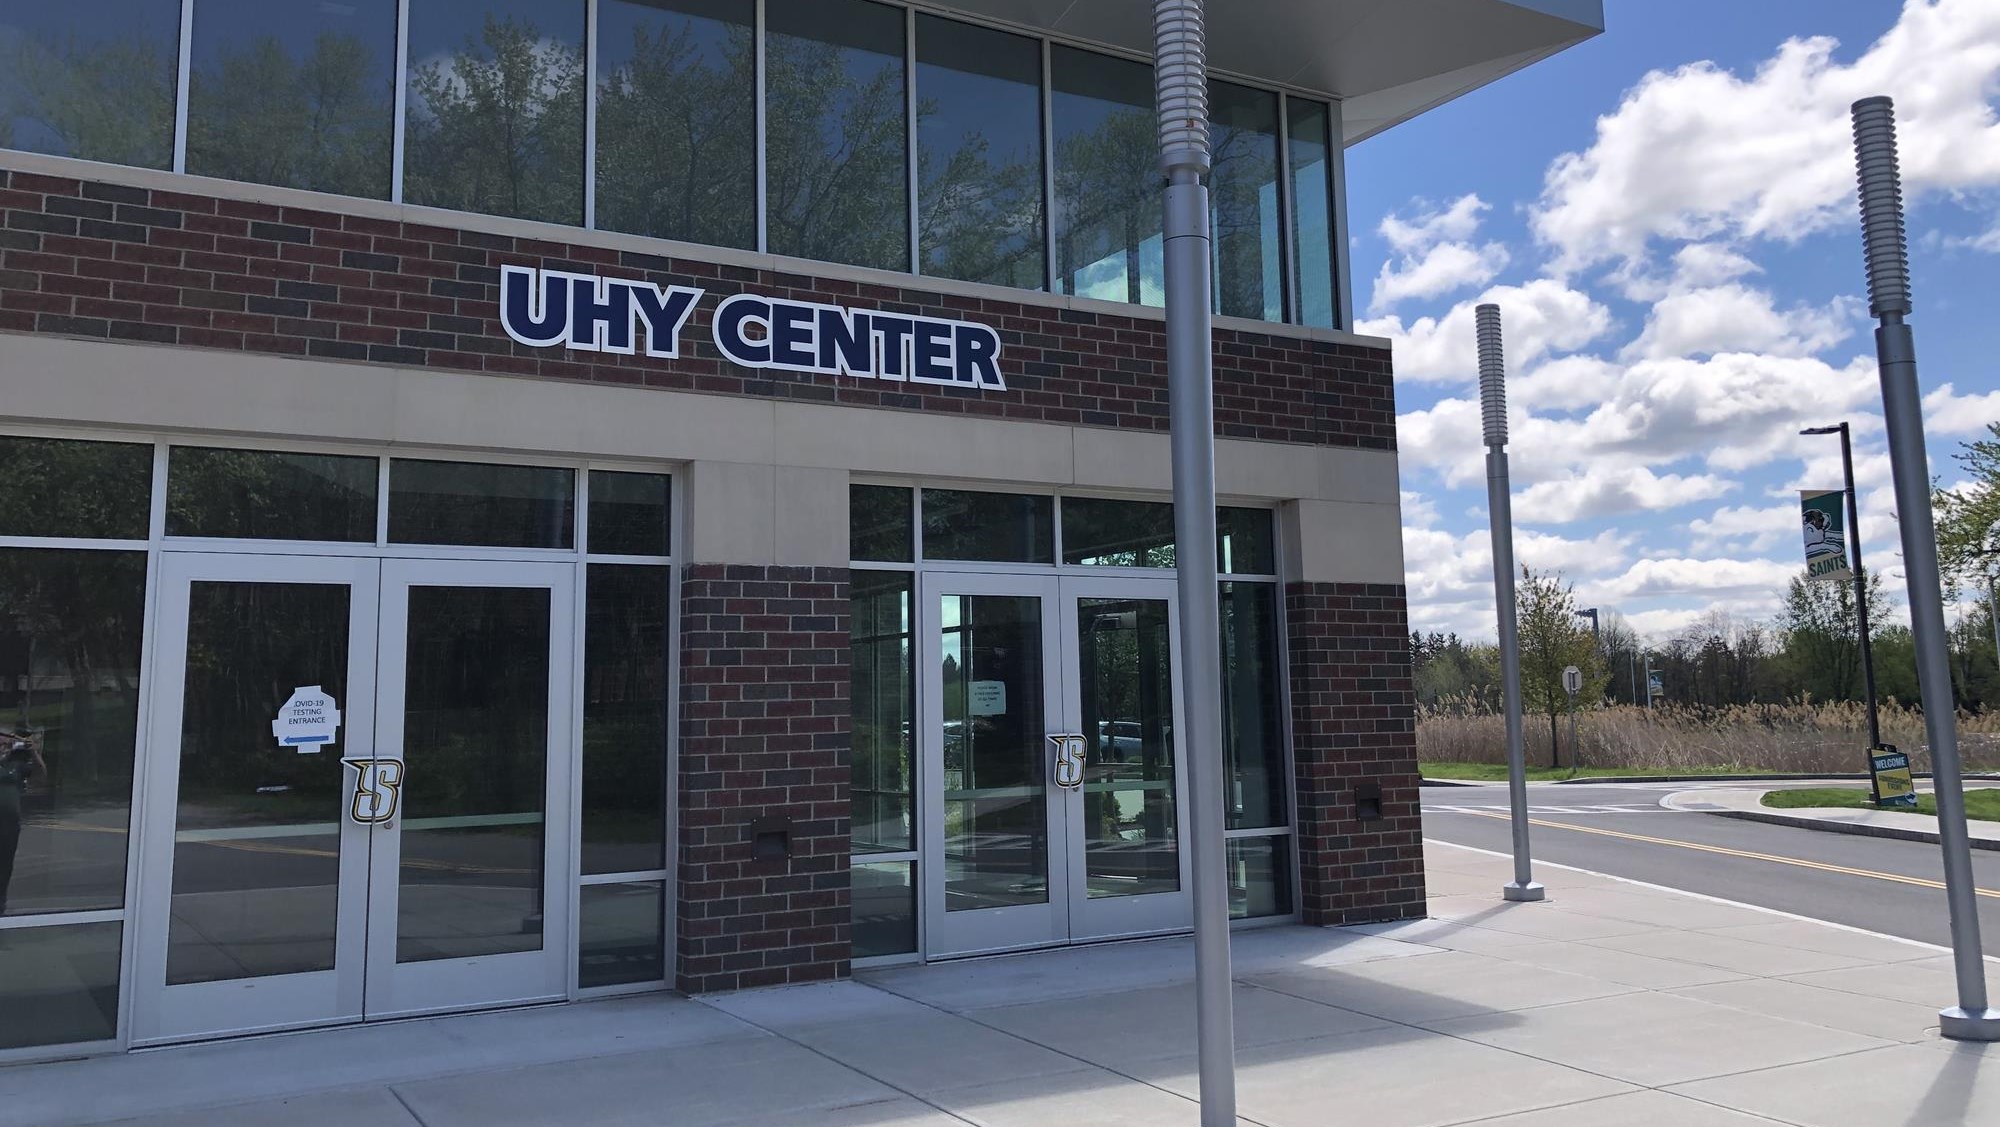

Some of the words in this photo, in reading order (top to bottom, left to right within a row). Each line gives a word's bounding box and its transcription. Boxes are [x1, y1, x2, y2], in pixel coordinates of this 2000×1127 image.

[500, 264, 705, 360] UHY
[712, 293, 1007, 392] CENTER
[1808, 555, 1848, 578] SAINTS
[293, 699, 325, 708] OVID-19
[293, 708, 322, 716] TESTING
[288, 717, 326, 725] ENTRANCE
[1874, 757, 1906, 770] WELCOME
